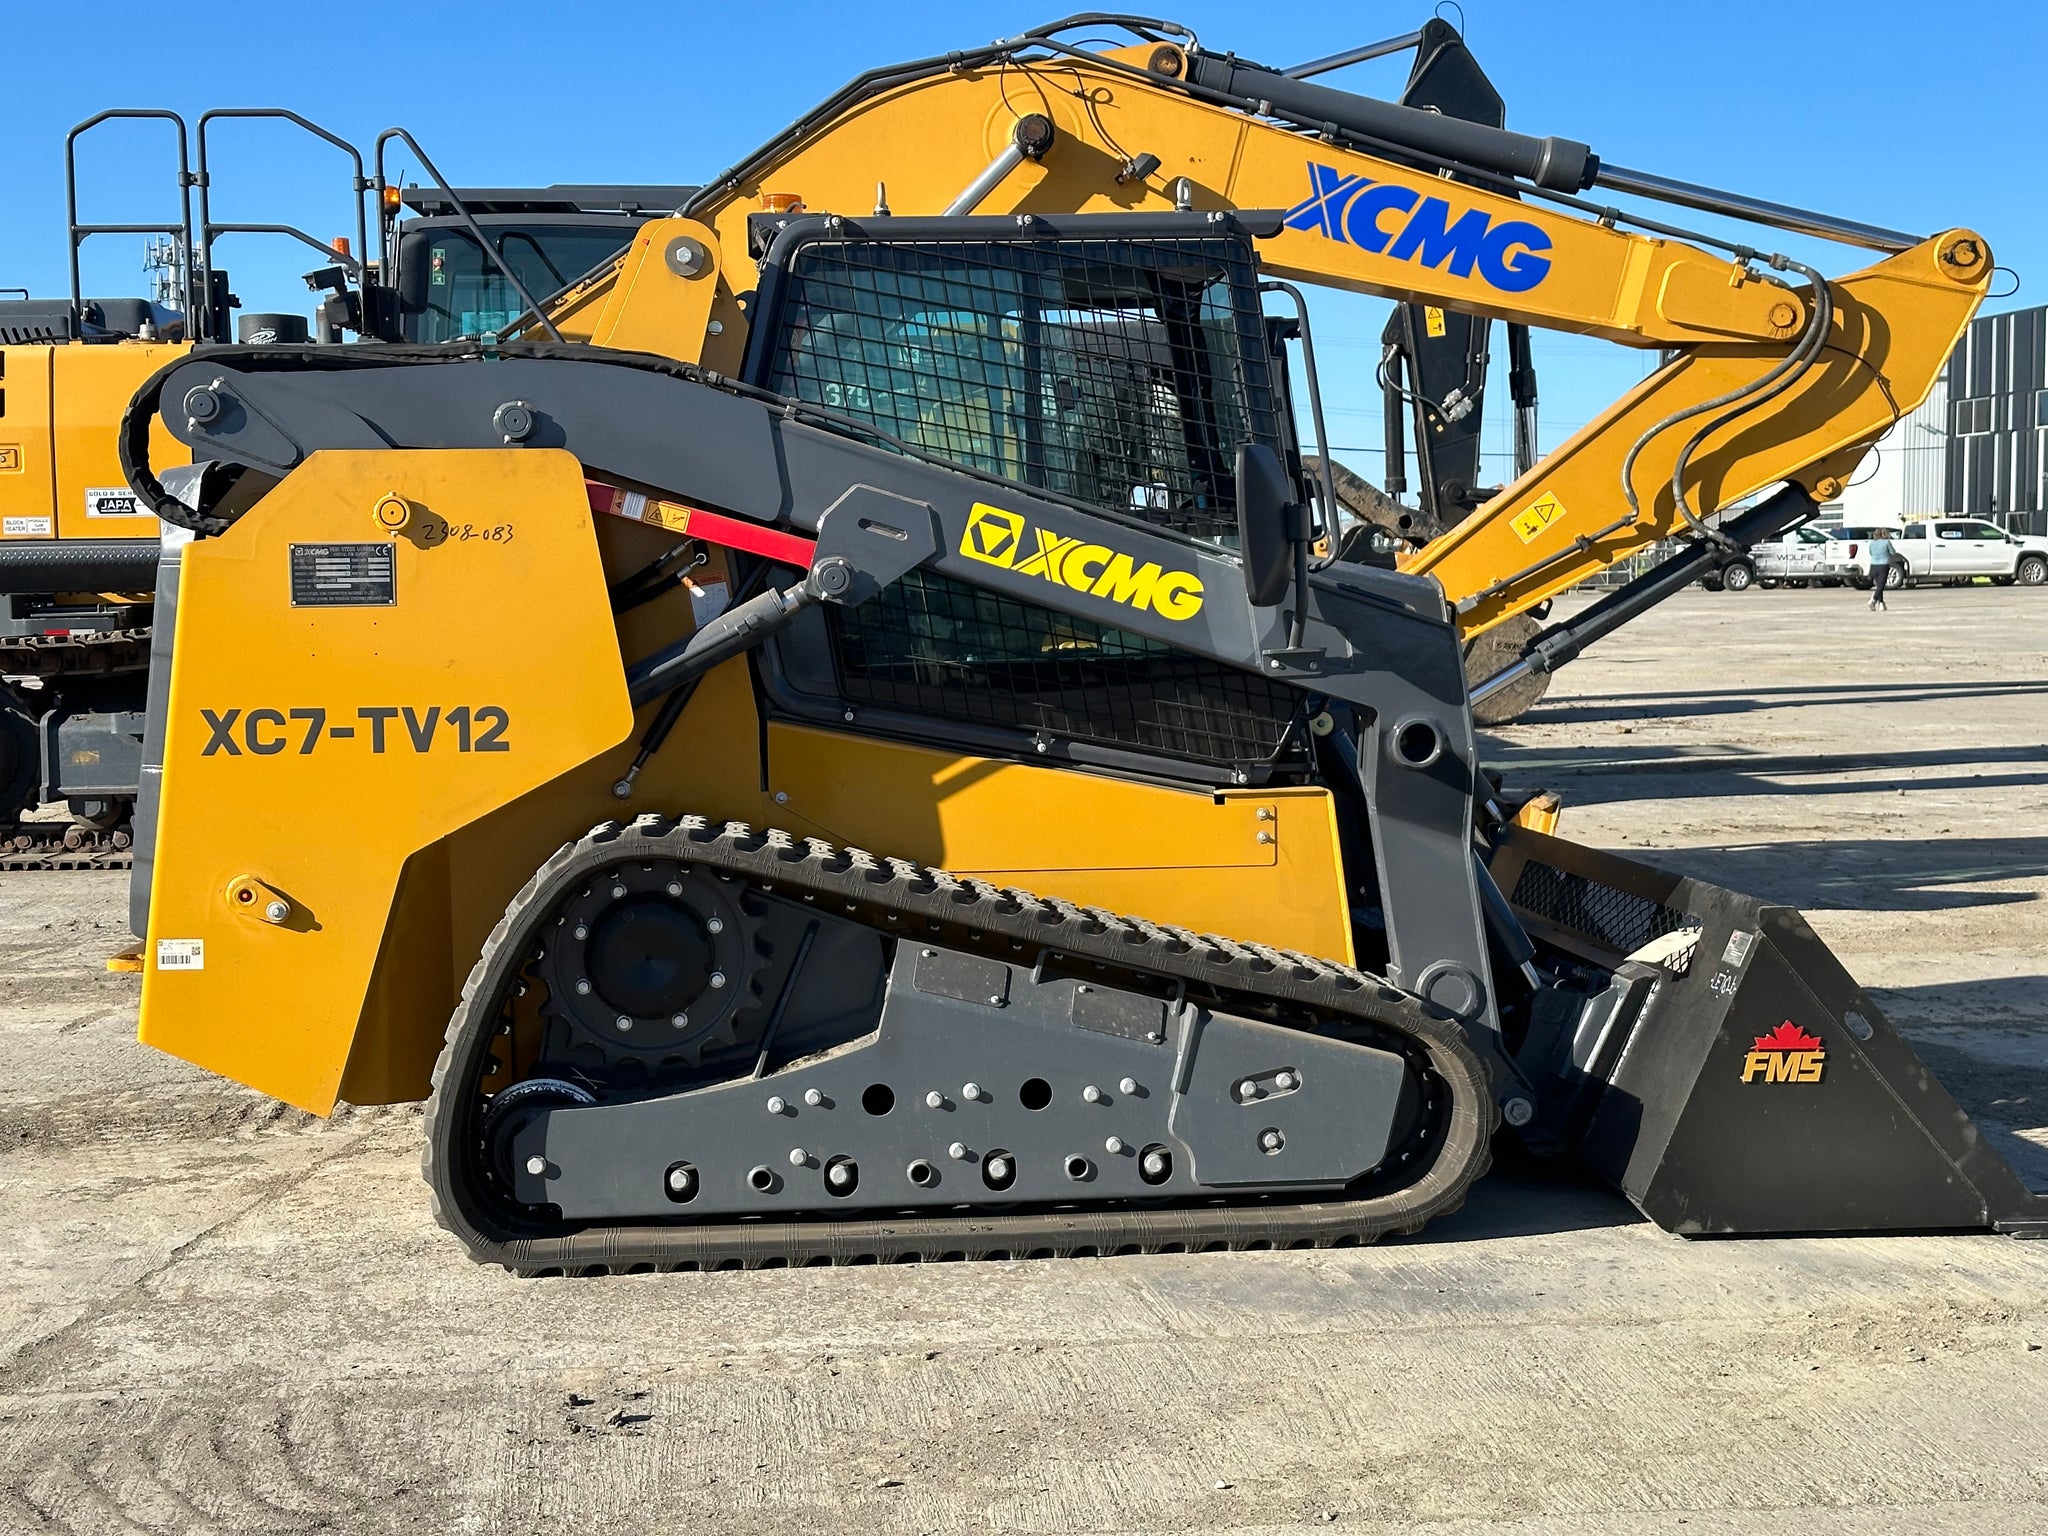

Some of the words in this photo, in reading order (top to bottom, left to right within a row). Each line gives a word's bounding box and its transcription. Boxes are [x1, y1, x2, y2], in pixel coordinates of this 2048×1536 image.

[1282, 160, 1553, 293] XCMG
[100, 500, 132, 509] JAPA
[421, 521, 514, 545] 2308-083
[304, 548, 329, 556] XCMG
[375, 546, 388, 556] CE
[1776, 553, 1815, 561] WOLFE
[1011, 527, 1205, 621] XCMG
[200, 706, 510, 756] XC7-TV12
[1743, 1051, 1825, 1082] FMS
